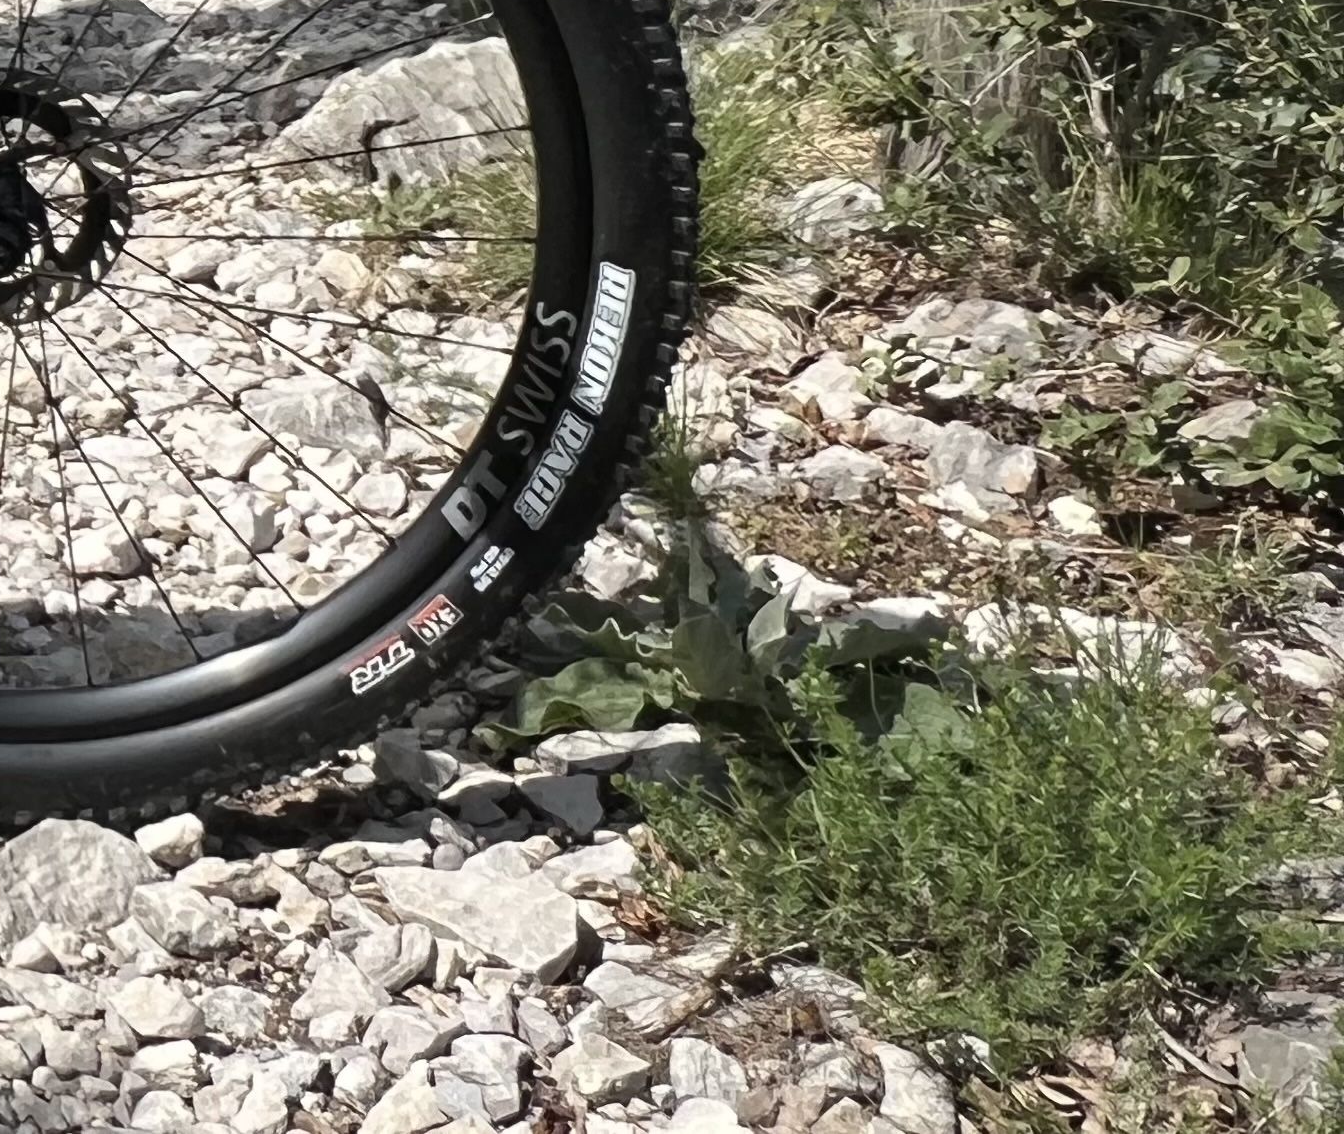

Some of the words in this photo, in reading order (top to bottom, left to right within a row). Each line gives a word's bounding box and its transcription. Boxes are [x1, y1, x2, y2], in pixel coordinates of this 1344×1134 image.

[570, 261, 636, 415] REKON
[440, 449, 508, 543] DT
[497, 301, 578, 456] SWISS
[514, 409, 594, 531] RACE
